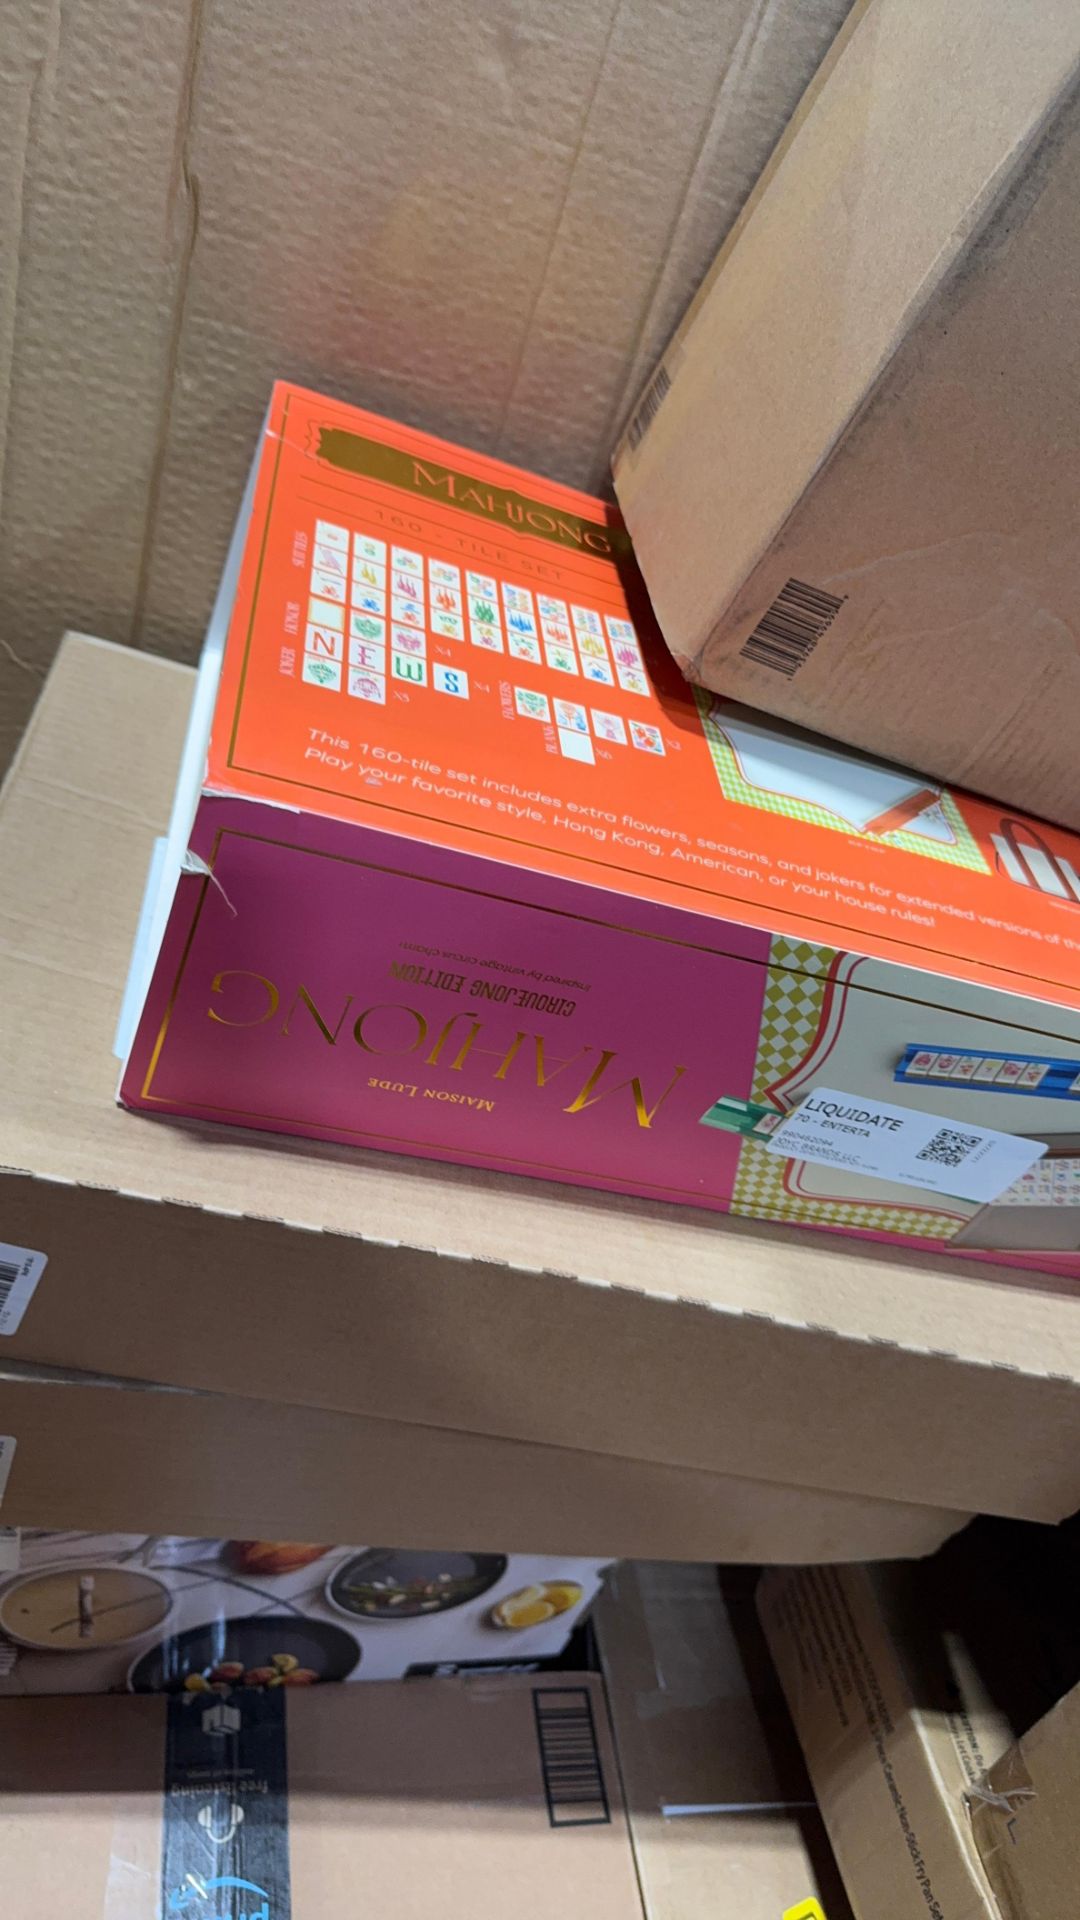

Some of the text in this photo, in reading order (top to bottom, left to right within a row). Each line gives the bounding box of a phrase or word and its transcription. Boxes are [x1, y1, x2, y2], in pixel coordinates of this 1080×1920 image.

[412, 461, 611, 553] MAHJONG
[374, 509, 422, 532] 160
[457, 538, 507, 563] TILE
[521, 559, 564, 581] SET
[444, 671, 459, 693] S
[304, 747, 936, 927] Play your favorite style, Hong Kong, American, or your house rules!
[309, 728, 350, 750] This
[359, 743, 442, 775] 160-tile
[446, 767, 477, 785] set
[482, 774, 562, 809] includes
[567, 800, 617, 824] extra
[622, 815, 692, 846] flowers,
[696, 838, 773, 868] seasons,
[777, 857, 812, 877] and
[814, 866, 866, 893] jokers
[869, 882, 894, 899] for
[896, 890, 976, 921] extended
[977, 915, 1042, 941] versions
[1043, 933, 1060, 945] of
[442, 948, 478, 966] circus
[479, 958, 526, 975] vintage
[387, 959, 468, 993] EDITION
[529, 968, 544, 982] by
[207, 969, 688, 1129] MAHJONG
[366, 1077, 496, 1113] MAISON LUDE
[804, 1098, 904, 1132] LIQUIDATE
[820, 1120, 871, 1138] ENTERTA
[914, 1859, 928, 1881] Fry
[921, 1879, 934, 1903] Pan
